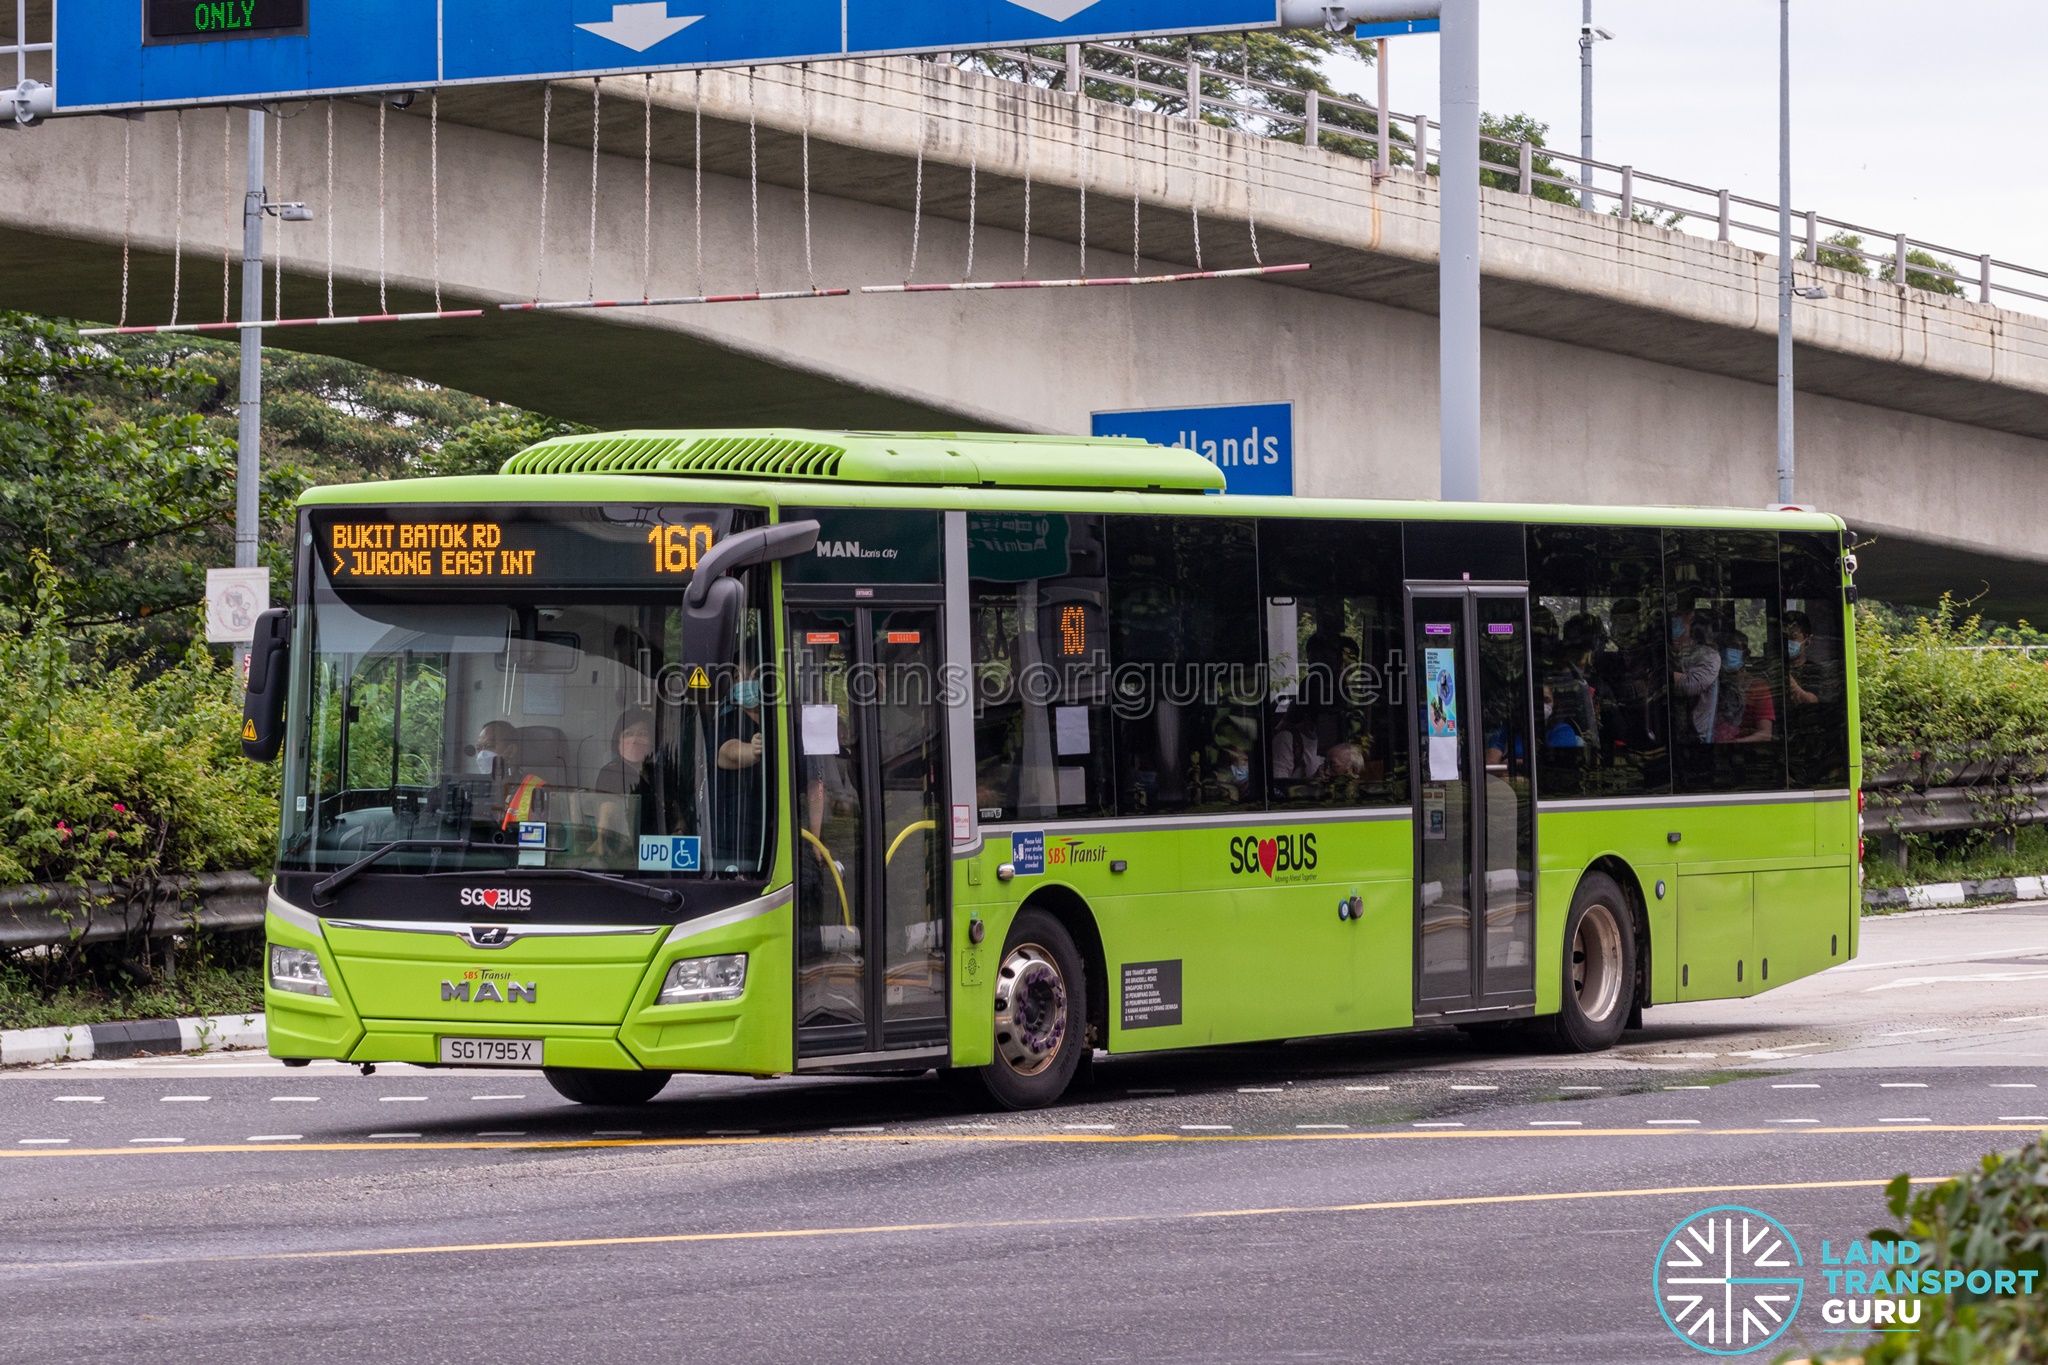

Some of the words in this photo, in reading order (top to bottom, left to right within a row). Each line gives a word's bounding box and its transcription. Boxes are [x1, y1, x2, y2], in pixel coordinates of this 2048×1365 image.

[195, 0, 255, 30] ONLY
[1102, 426, 1279, 467] dlands
[333, 525, 395, 549] BUKIT
[400, 524, 468, 548] BATOK
[472, 524, 501, 548] RD
[647, 524, 713, 573] 160
[350, 551, 432, 575] JURONG
[441, 551, 495, 575] EAST
[500, 550, 536, 575] INT
[816, 541, 860, 558] MAN
[860, 548, 881, 558] Lion's
[882, 548, 898, 560] City
[1060, 606, 1085, 655] 160
[640, 843, 669, 862] UPD
[1047, 847, 1067, 865] SBS
[1065, 841, 1108, 867] Transit
[463, 970, 479, 980] SBS
[480, 969, 512, 980] Transit
[441, 980, 537, 1004] MAN
